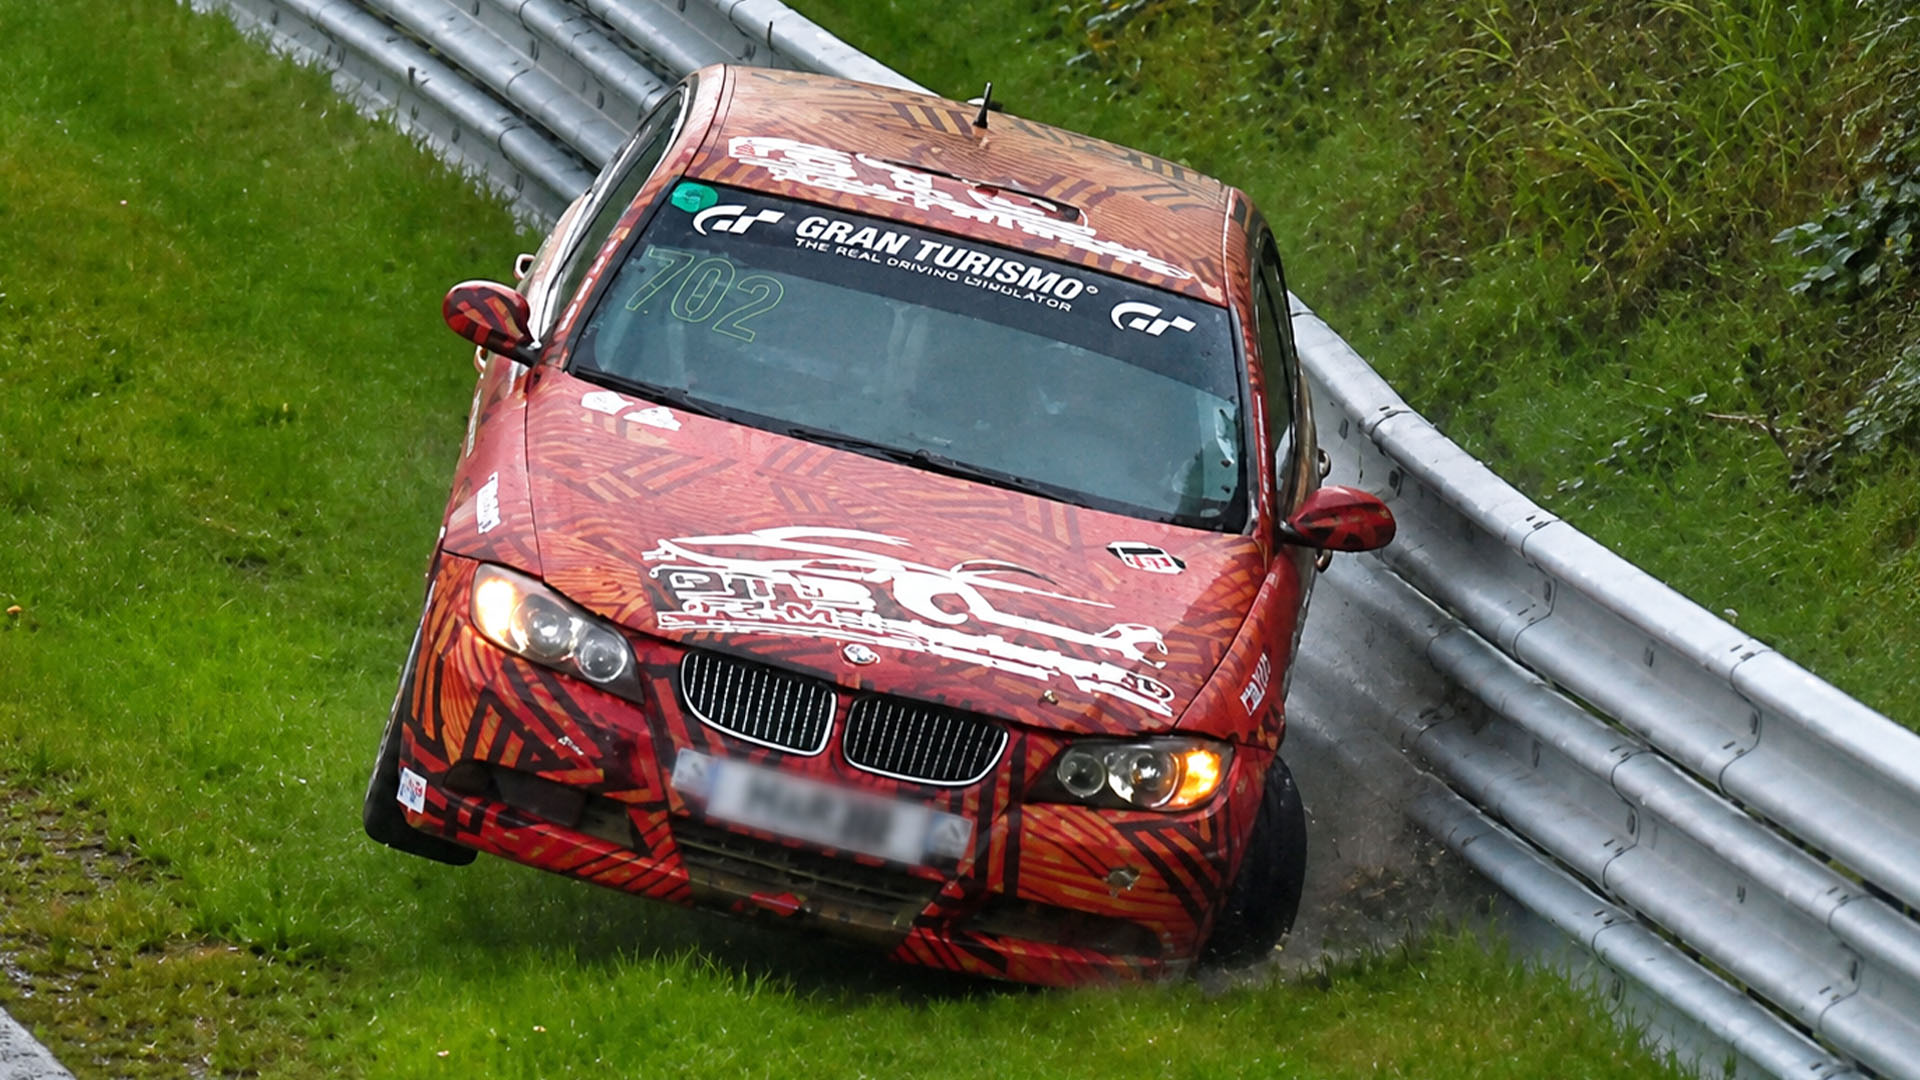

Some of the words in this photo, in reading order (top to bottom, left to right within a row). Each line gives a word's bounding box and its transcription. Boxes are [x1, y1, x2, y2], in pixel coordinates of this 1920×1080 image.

[795, 216, 910, 255] GRAN
[795, 237, 830, 253] THE
[835, 245, 881, 264] REAL
[625, 246, 784, 343] 702
